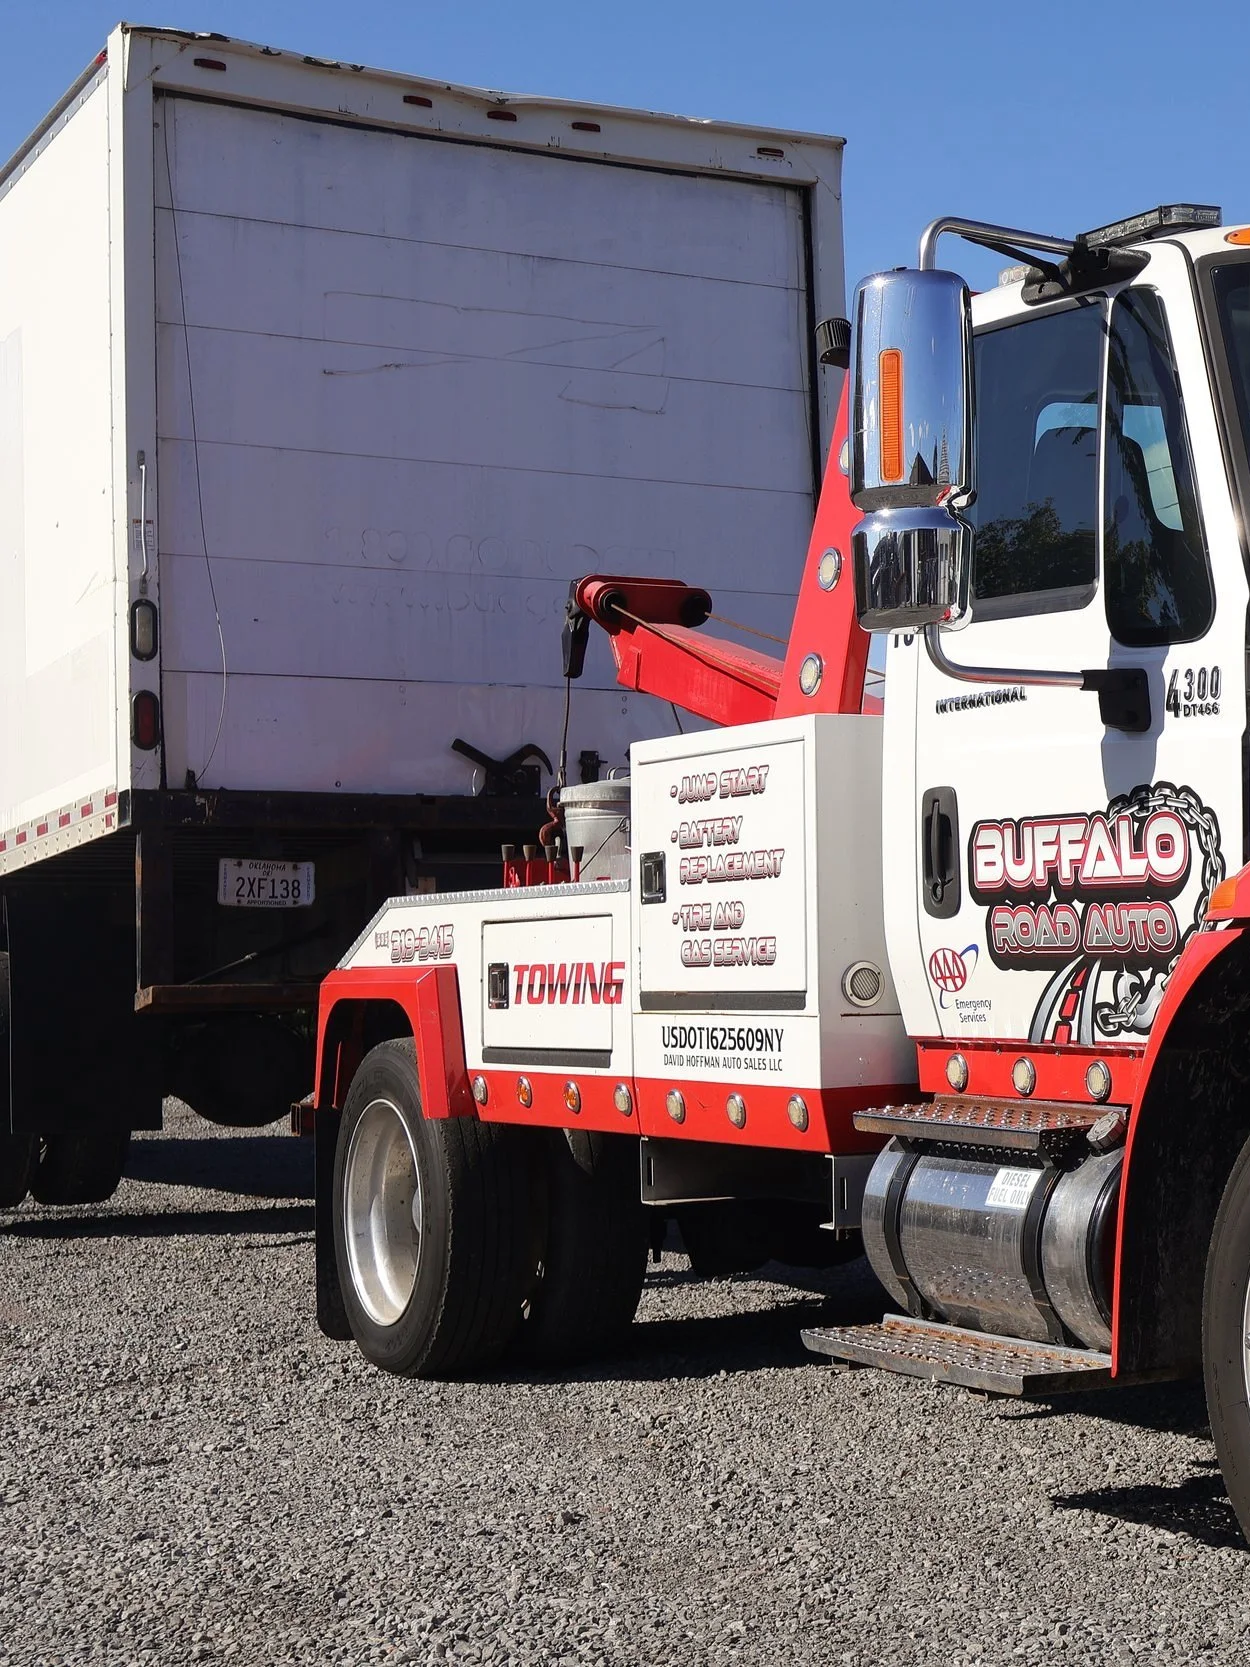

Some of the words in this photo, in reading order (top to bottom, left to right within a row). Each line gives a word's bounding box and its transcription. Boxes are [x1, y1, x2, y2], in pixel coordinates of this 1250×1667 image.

[935, 686, 1028, 715] INTERNATIONAL
[1166, 665, 1222, 718] 4300
[1183, 702, 1221, 717] DT466
[678, 772, 718, 804] JUMP
[719, 764, 770, 799] START
[679, 815, 744, 850] BATTERY
[248, 861, 287, 872] OKLAHOMA
[679, 848, 785, 885] REPLACEMENT
[973, 811, 1190, 891] BUFFALO
[235, 876, 301, 899] 2XF138
[680, 903, 712, 932] TIRE
[713, 900, 745, 930] AND
[991, 904, 1081, 953] ROAD
[1084, 901, 1178, 953] AUTO
[390, 924, 455, 964] 319-3415
[680, 939, 712, 968] GAS
[713, 936, 777, 967] SERVICE
[513, 961, 626, 1005] TOWING
[930, 949, 966, 991] AAA
[955, 999, 992, 1011] Emergency
[959, 1012, 986, 1023] Services
[662, 1025, 784, 1052] USDOT1625609NY
[663, 1054, 684, 1066] DAVID
[686, 1055, 720, 1068] HOFFMAN
[722, 1056, 741, 1069] AUTO
[744, 1057, 767, 1070] SALES
[769, 1058, 783, 1071] LLC
[988, 1187, 1008, 1203] FUEL
[1002, 1171, 1031, 1188] DIESEL
